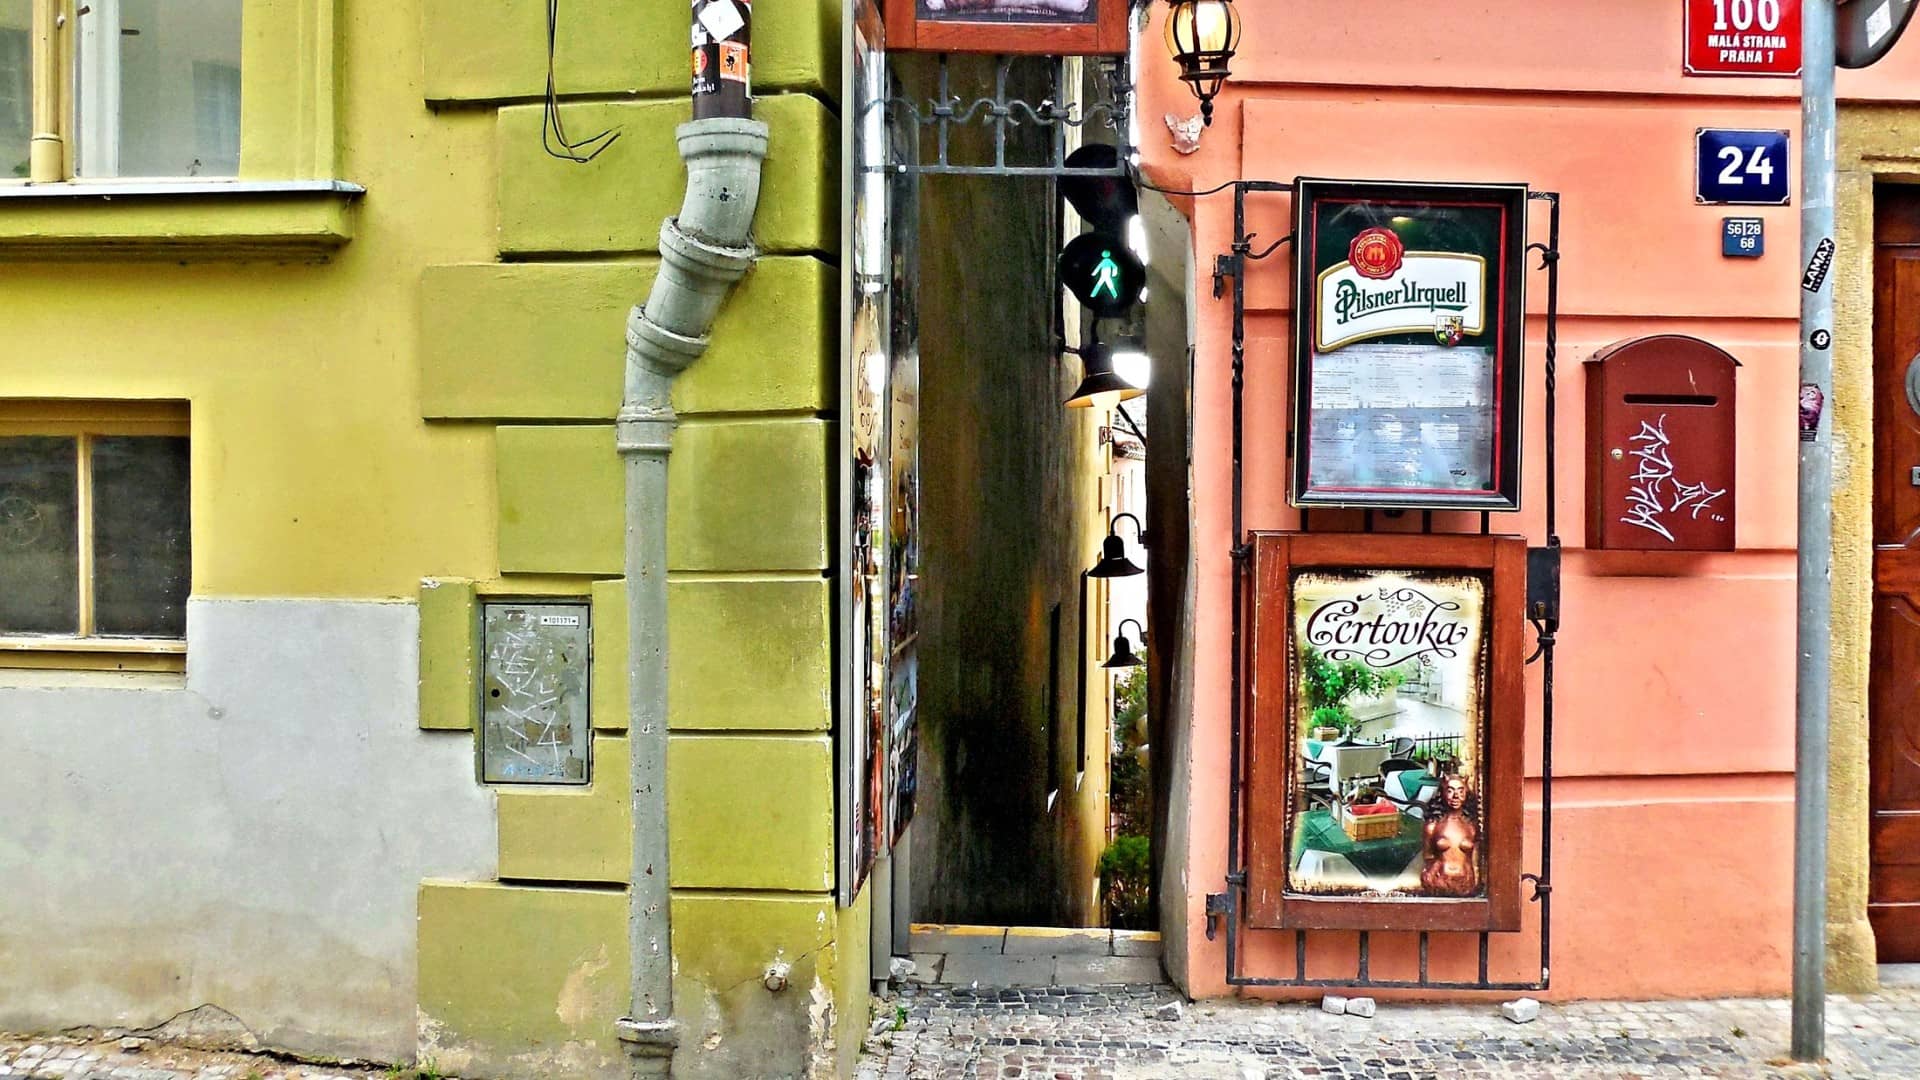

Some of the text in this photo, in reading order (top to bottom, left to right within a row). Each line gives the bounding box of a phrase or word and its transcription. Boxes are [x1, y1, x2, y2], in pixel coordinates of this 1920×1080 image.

[1713, 0, 1780, 31] 100
[1708, 33, 1787, 48] MALÁ STRANA
[1719, 50, 1775, 63] PRAHA 1
[1717, 145, 1774, 185] 24
[1740, 237, 1755, 249] 68
[1803, 239, 1833, 289] LAMAX
[1334, 277, 1467, 326] Pilsner Urquell
